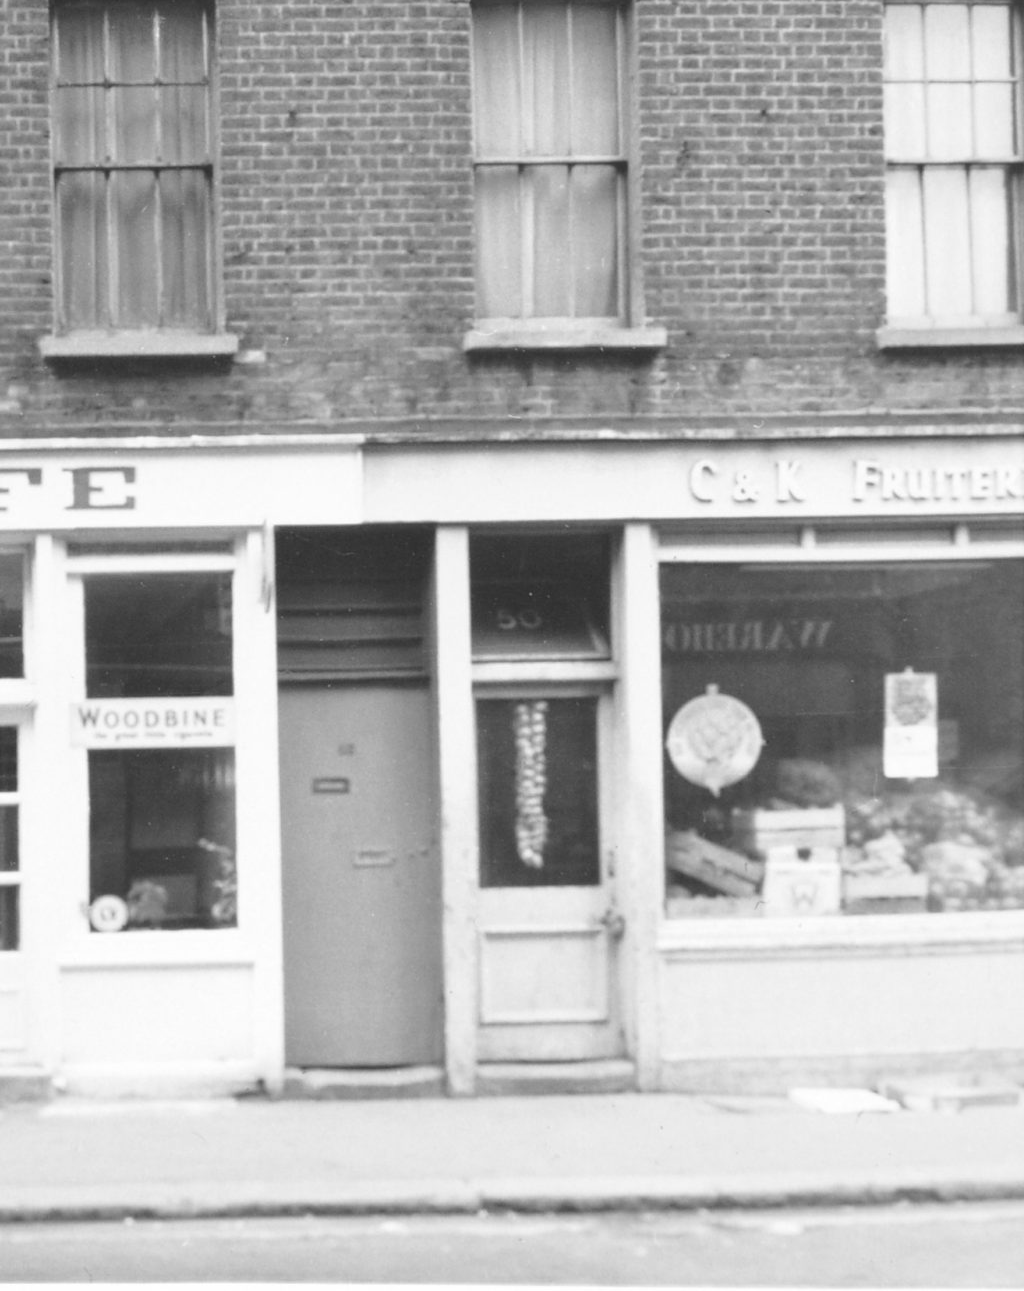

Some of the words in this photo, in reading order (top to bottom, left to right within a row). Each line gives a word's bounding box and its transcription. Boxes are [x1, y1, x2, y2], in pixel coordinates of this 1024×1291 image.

[689, 460, 716, 503] C
[732, 470, 758, 503] &
[775, 460, 805, 503] K
[78, 708, 226, 729] WOODBINE
